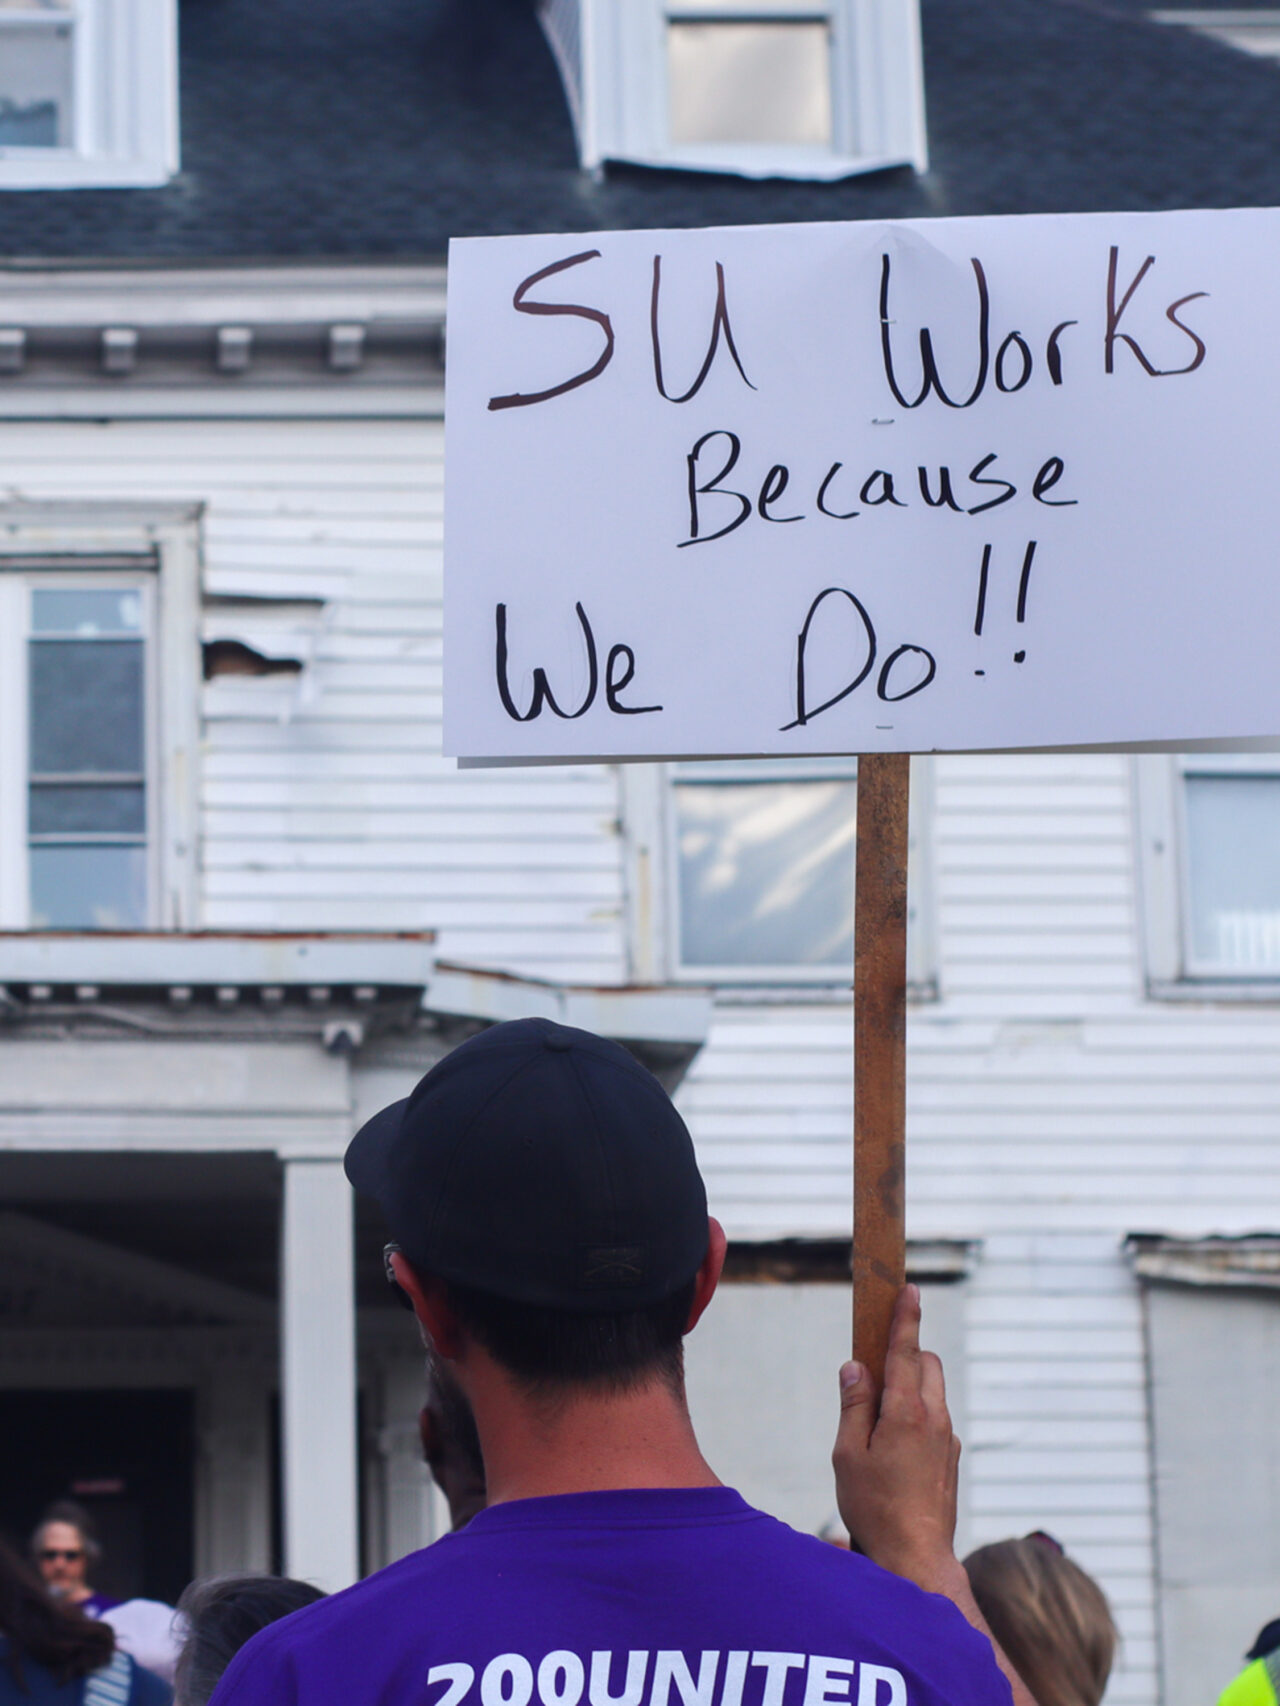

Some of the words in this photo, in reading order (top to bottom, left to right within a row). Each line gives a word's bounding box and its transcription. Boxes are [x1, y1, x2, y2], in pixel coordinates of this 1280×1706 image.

[487, 249, 758, 412] SU
[676, 429, 1080, 549] Because
[494, 600, 663, 722] We
[426, 1649, 909, 1706] 200UNITED
